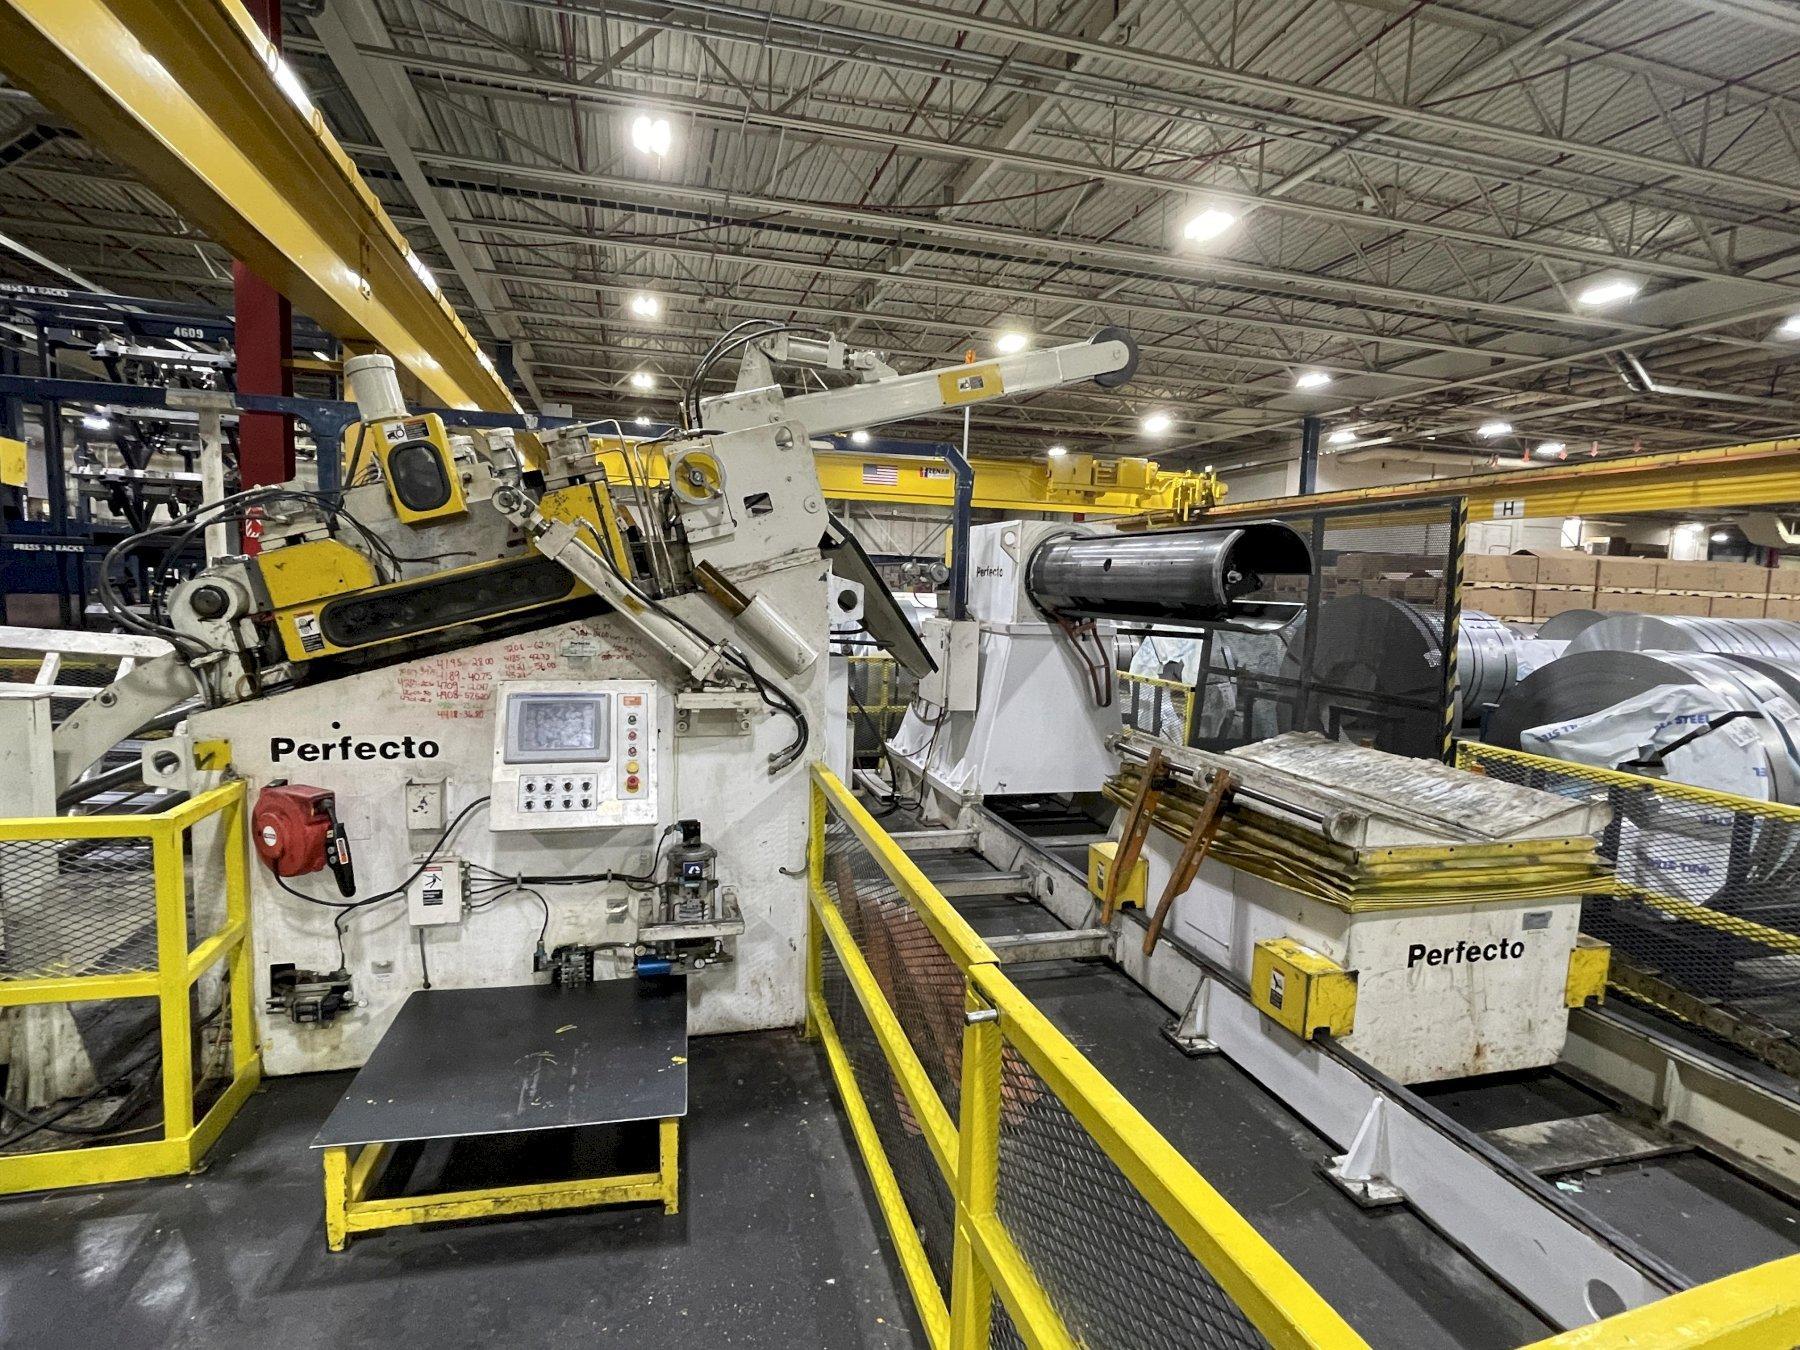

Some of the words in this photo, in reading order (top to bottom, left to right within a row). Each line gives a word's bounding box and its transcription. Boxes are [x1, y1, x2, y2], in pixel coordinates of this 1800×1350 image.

[173, 326, 204, 339] 4609
[1503, 501, 1514, 516] H
[13, 543, 40, 551] PRESS
[55, 544, 85, 552] RACKS
[976, 565, 1004, 578] Perfecto
[1675, 714, 1709, 725] STEEL
[270, 735, 440, 763] Perfecto
[1407, 938, 1525, 968] Perfecto
